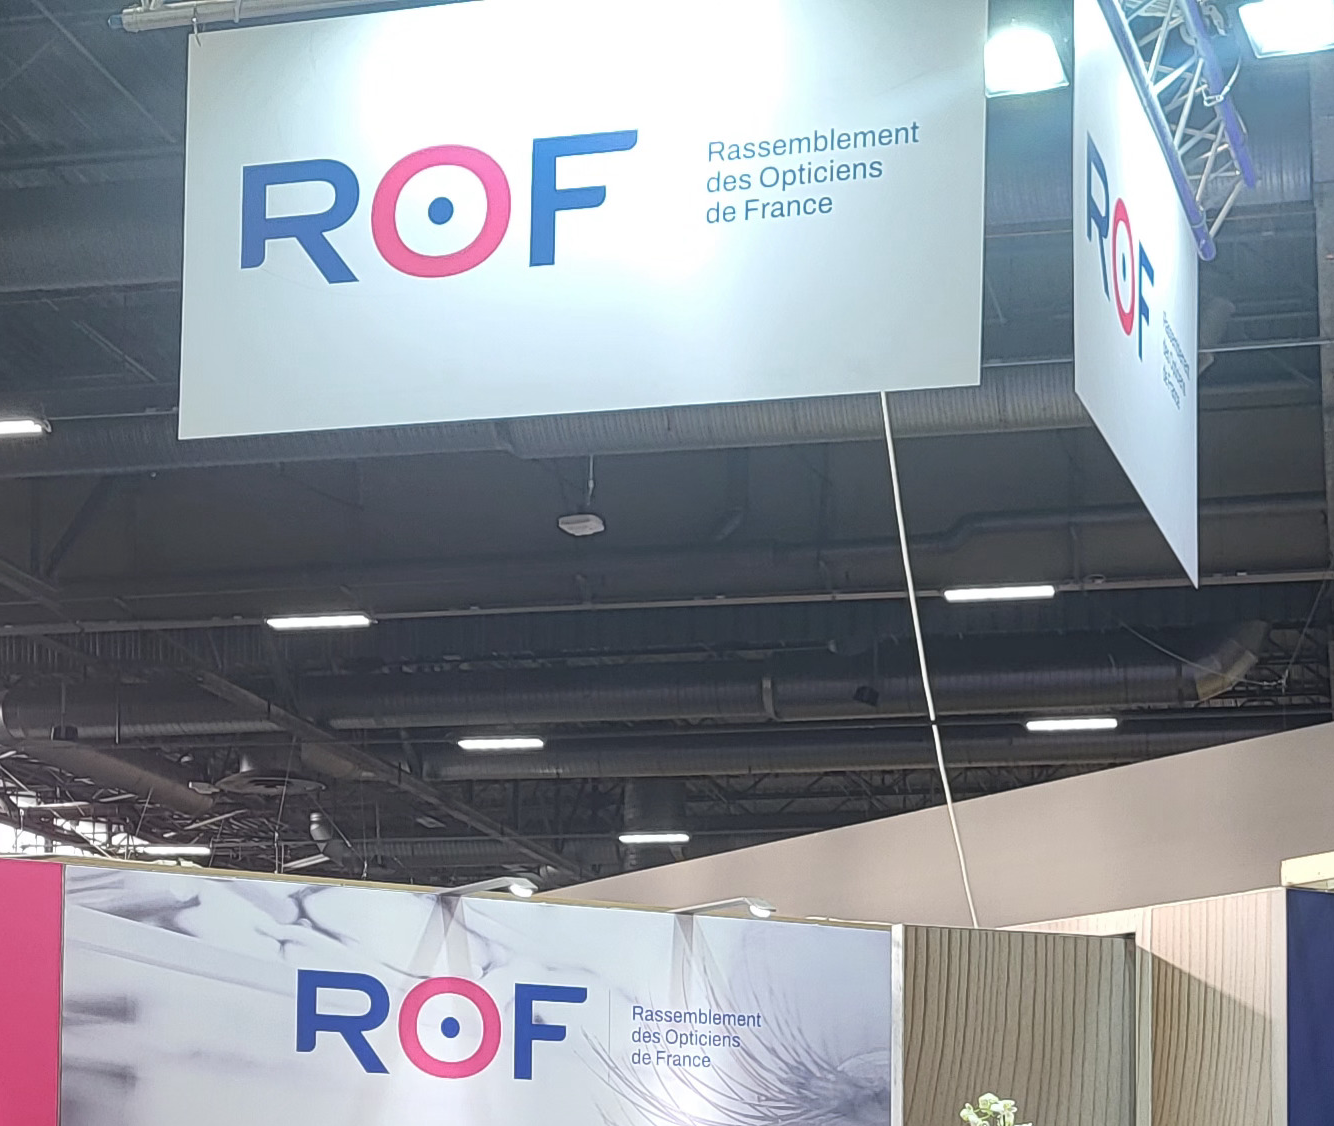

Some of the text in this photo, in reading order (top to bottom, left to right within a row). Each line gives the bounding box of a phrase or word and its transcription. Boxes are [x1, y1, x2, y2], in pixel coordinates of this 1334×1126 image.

[706, 120, 921, 164] Rassemblement
[705, 158, 885, 194] des Opticiens
[239, 128, 639, 286] ROF
[705, 194, 835, 226] de France
[1086, 129, 1154, 363] ROF
[296, 969, 588, 1080] ROF
[632, 1005, 762, 1028] Rassemblement
[631, 1027, 742, 1048] des Opticiens
[631, 1049, 712, 1068] de France
